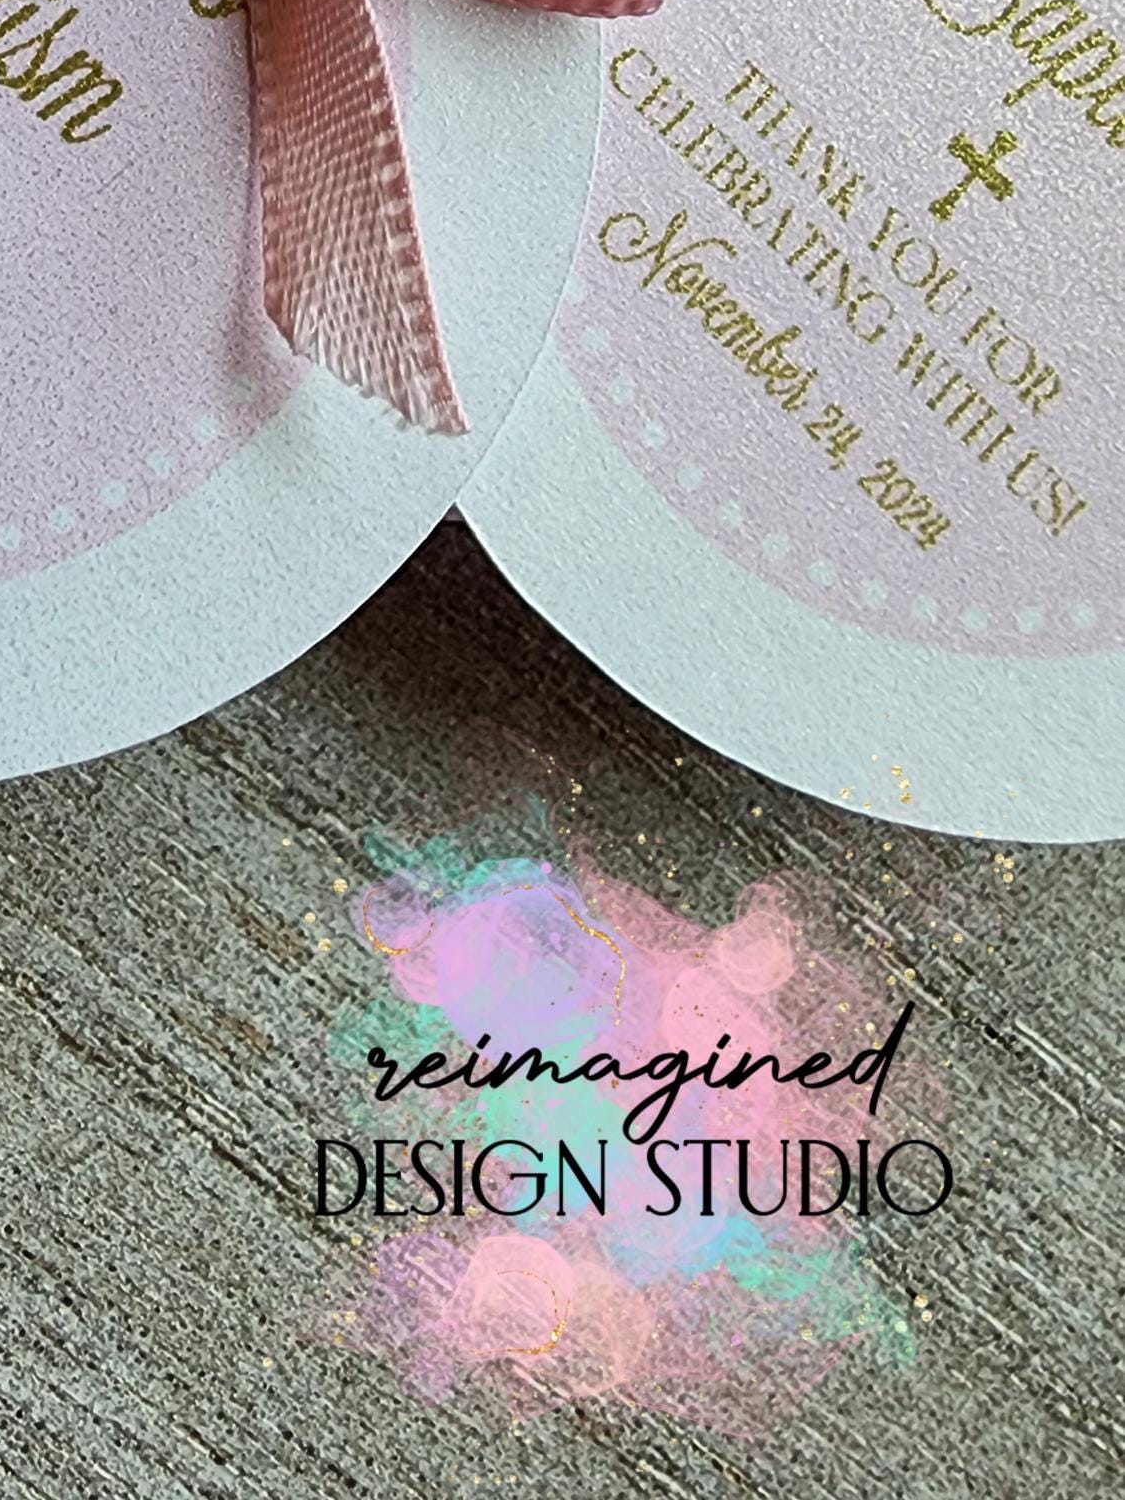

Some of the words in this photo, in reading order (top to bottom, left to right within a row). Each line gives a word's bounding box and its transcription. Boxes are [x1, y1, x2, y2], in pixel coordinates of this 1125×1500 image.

[597, 210, 819, 412] November
[804, 403, 862, 471] 24,
[858, 456, 951, 551] 2024
[609, 47, 896, 344] CELEBRATING
[896, 332, 1016, 462] WITH
[1006, 451, 1087, 536] US!
[726, 60, 871, 221] THANK
[869, 206, 971, 316] YOU
[960, 307, 1062, 419] FOR
